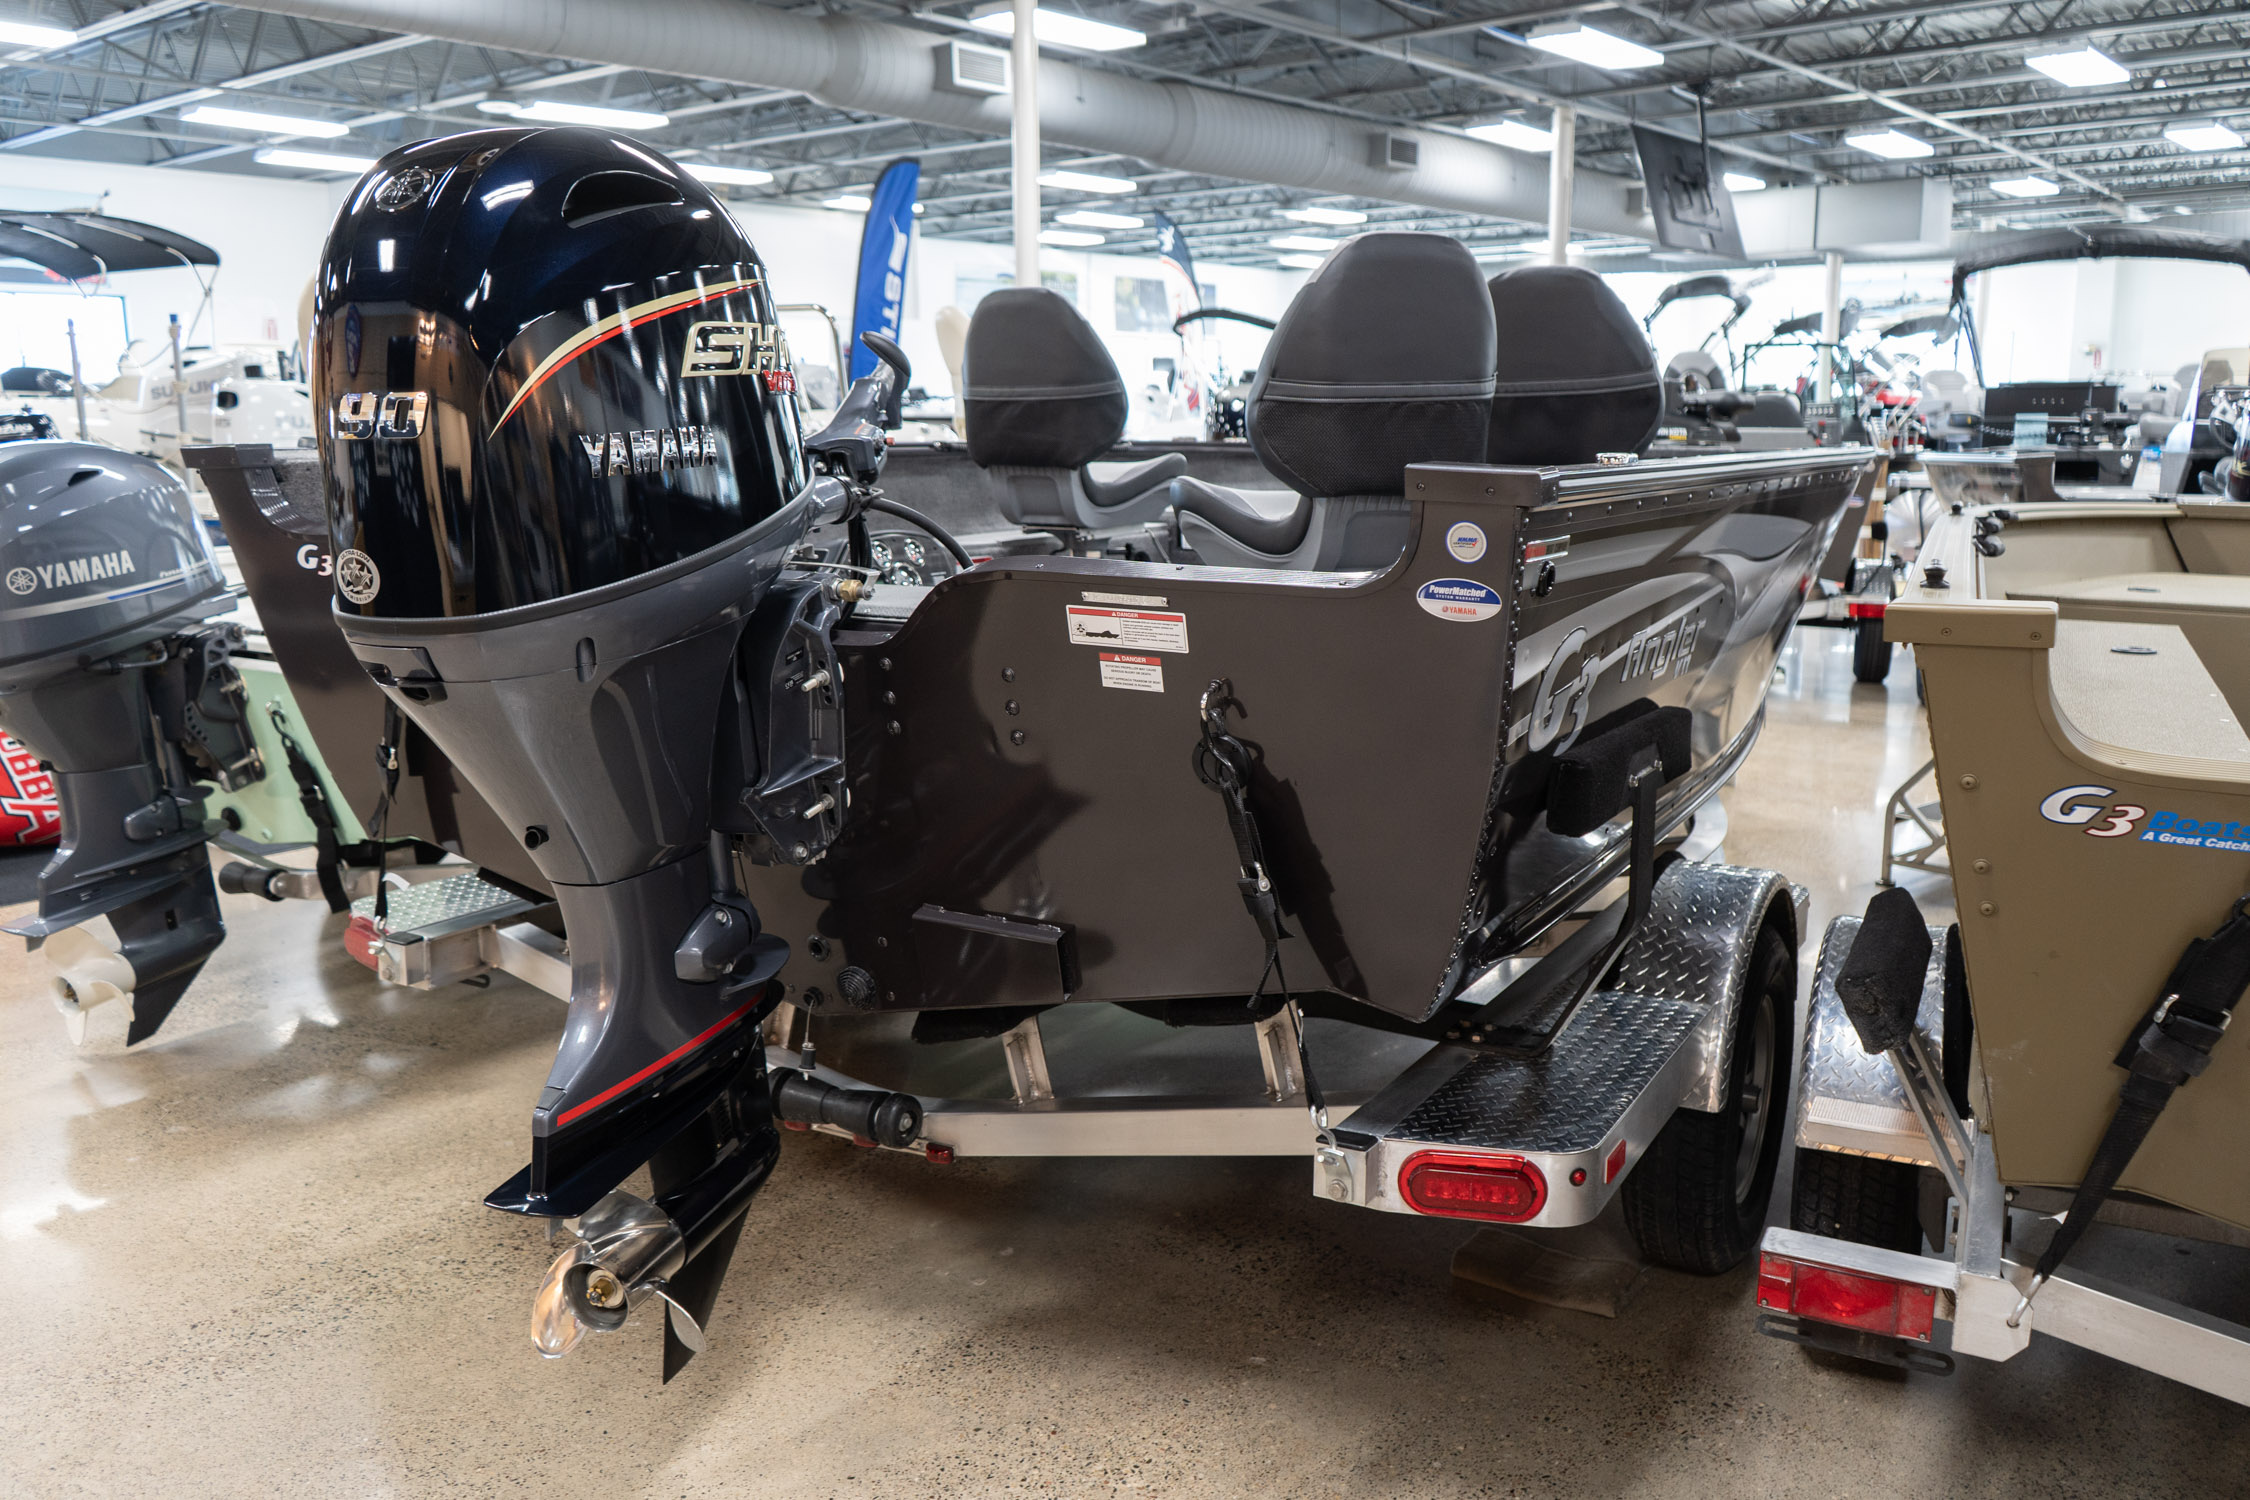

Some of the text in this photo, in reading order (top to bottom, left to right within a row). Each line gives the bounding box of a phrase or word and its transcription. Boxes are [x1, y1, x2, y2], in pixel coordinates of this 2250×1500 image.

[338, 391, 429, 440] 90
[578, 425, 718, 478] YAMAHA
[36, 550, 136, 590] YAMAHA
[296, 544, 333, 577] G3
[1429, 585, 1486, 598] PowerMatched
[1449, 606, 1477, 615] YAMAHA
[1121, 655, 1147, 663] DANGER
[1620, 615, 1707, 683] Angler
[2040, 784, 2250, 840] G3 Boats
[2142, 831, 2250, 852] A Great Catch
